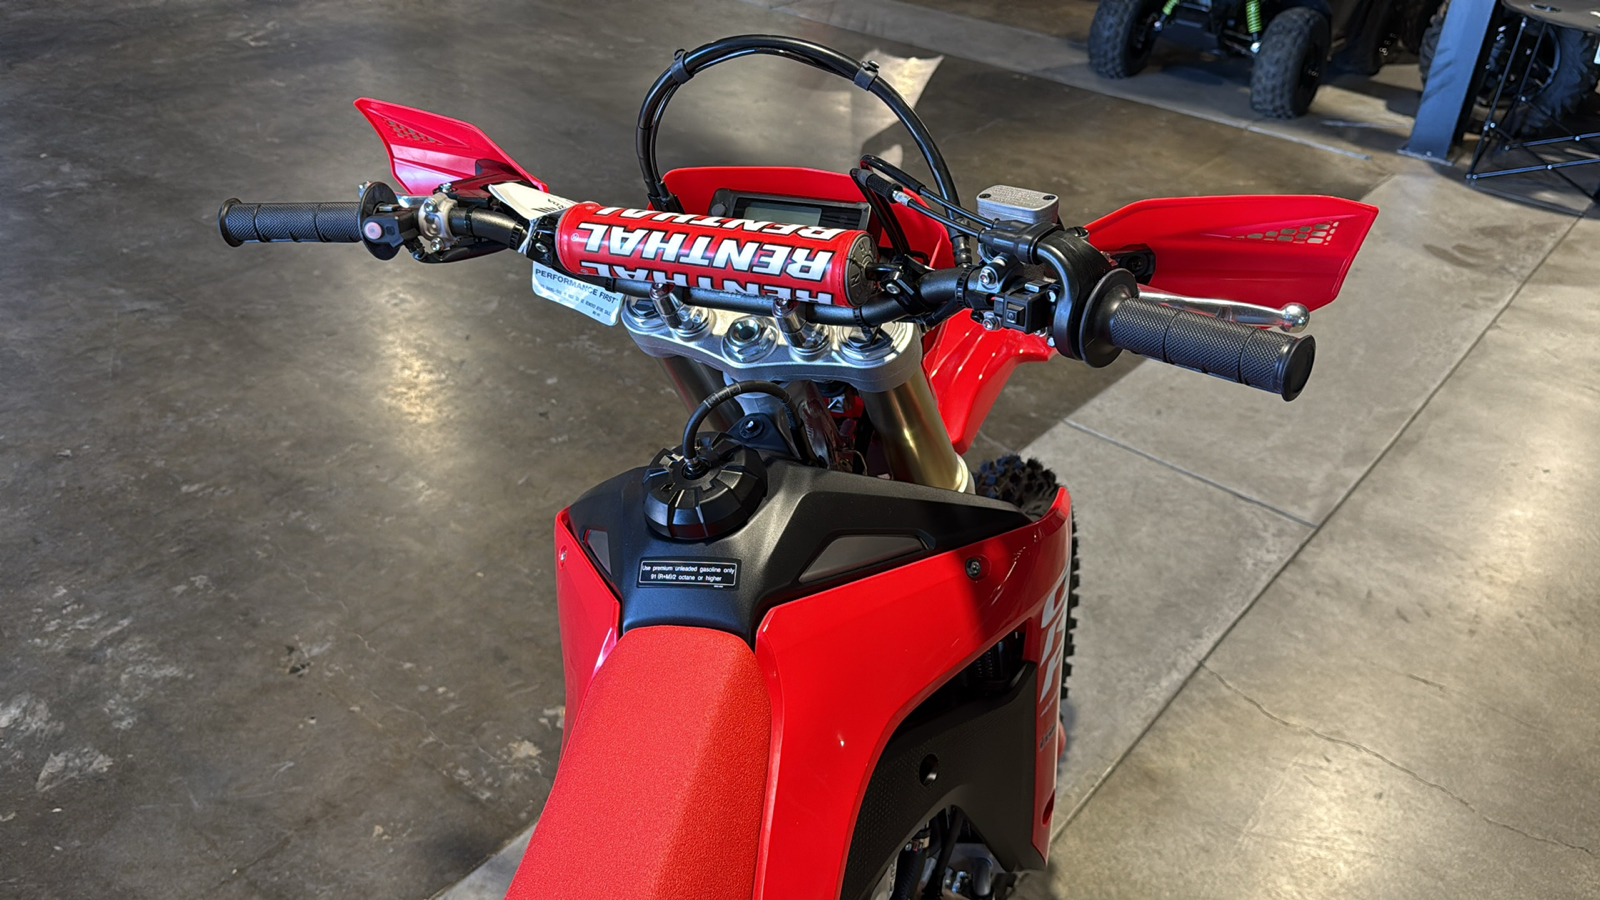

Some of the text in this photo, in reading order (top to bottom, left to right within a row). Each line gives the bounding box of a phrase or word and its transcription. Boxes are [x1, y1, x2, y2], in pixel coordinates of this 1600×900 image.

[577, 222, 834, 282] RENTHAL
[535, 268, 598, 296] PERFORMANCE
[723, 567, 735, 575] only
